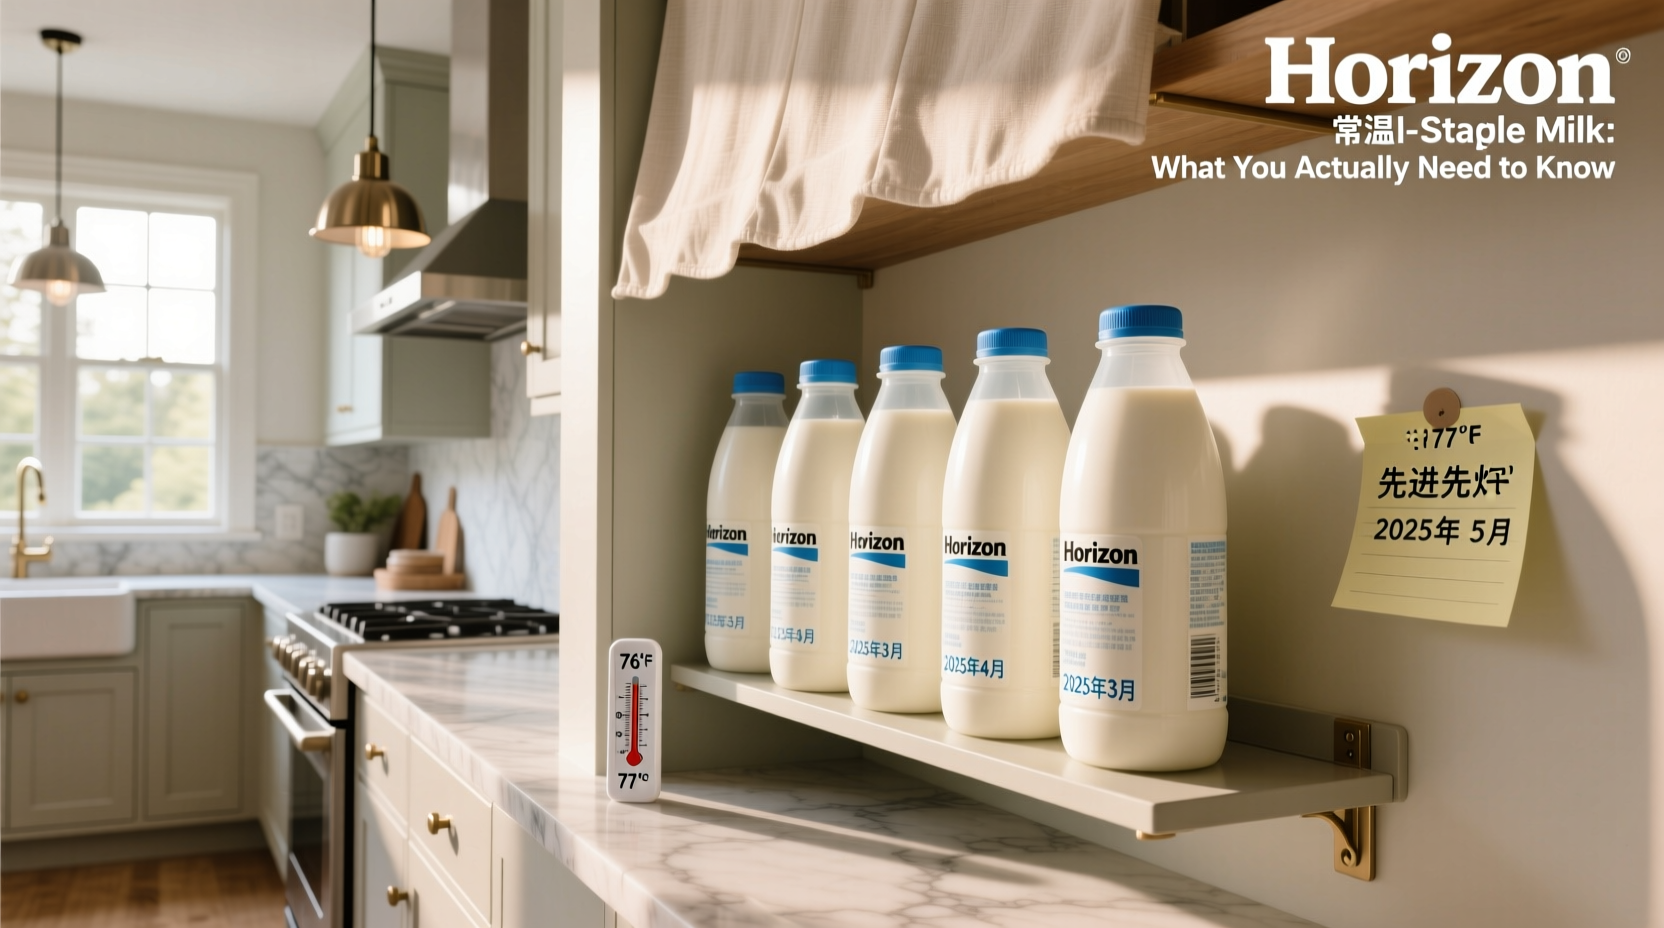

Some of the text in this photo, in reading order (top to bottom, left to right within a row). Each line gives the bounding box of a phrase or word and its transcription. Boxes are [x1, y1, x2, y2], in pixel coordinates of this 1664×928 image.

[1373, 515, 1511, 546] 2025年 5月
[944, 535, 1007, 557] Horizon
[1063, 540, 1138, 565] Horizon
[944, 654, 1004, 679] 2025年4月
[1063, 673, 1135, 702] 2025年3月
